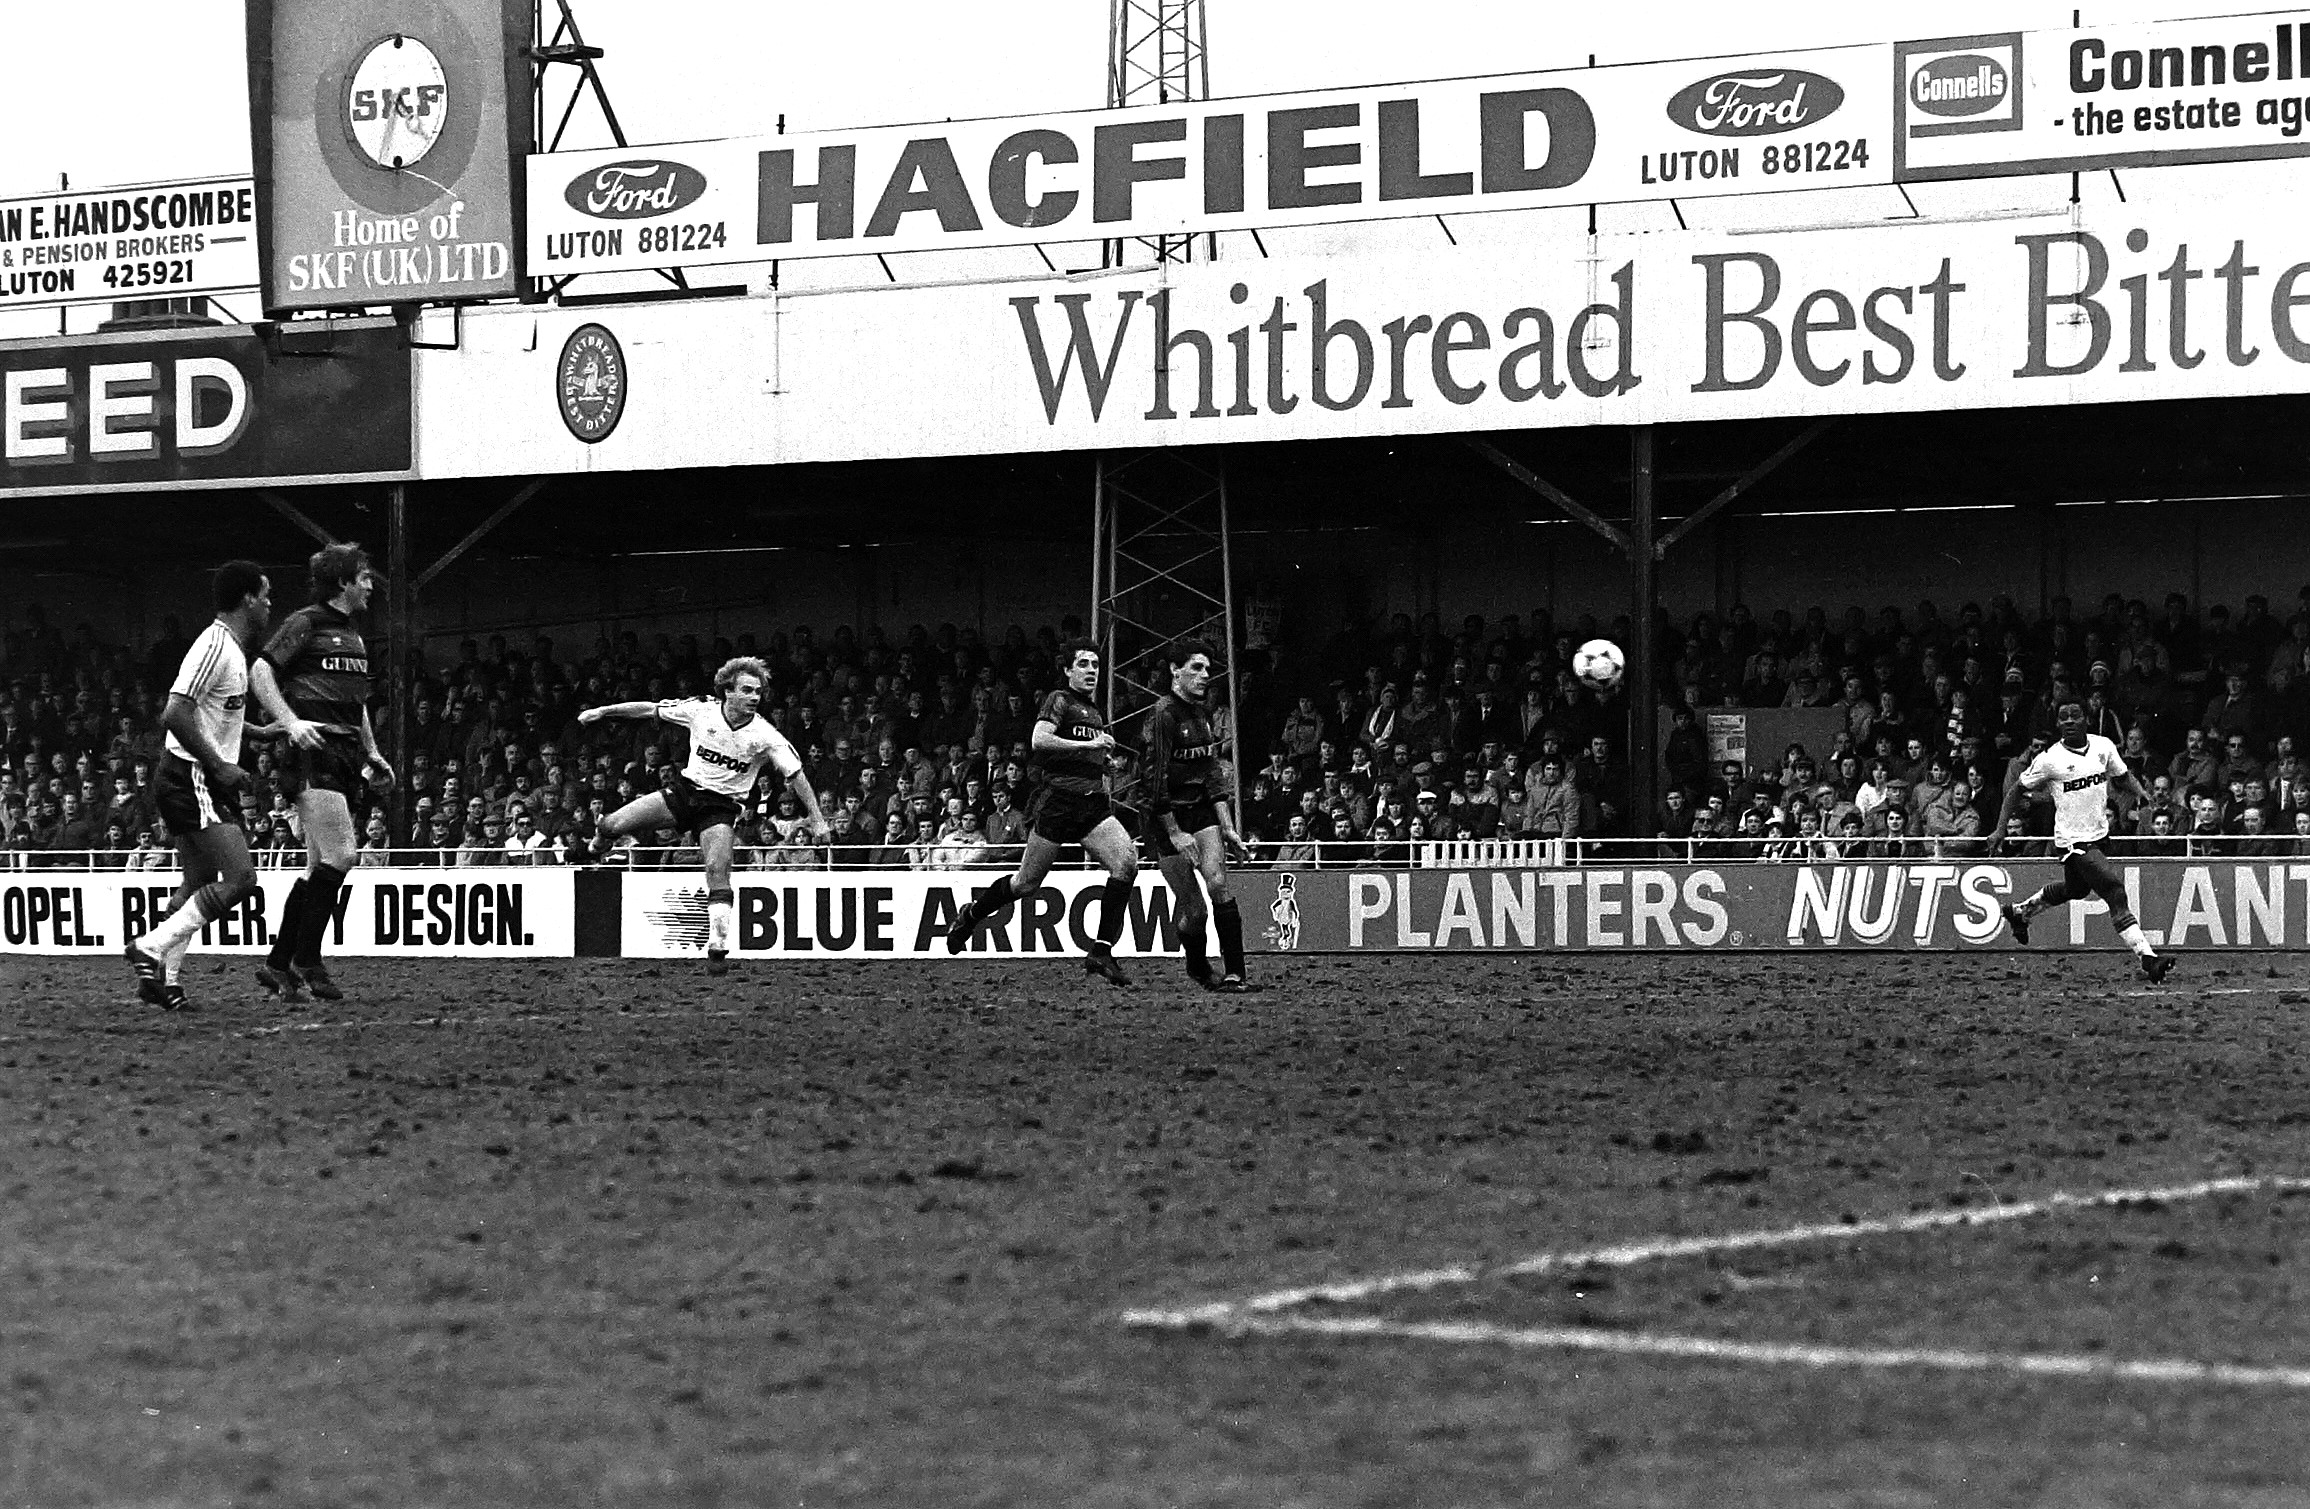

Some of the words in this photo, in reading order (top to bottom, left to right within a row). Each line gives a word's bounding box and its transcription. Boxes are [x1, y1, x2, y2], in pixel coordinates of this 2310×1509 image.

[353, 84, 445, 121] SKF
[1695, 74, 1809, 129] Ford
[1917, 65, 2004, 102] Connells
[2072, 102, 2123, 136] the
[2134, 97, 2241, 131] estate
[2256, 96, 2310, 137] ag
[757, 87, 1596, 244] HACFIELD
[1642, 148, 1739, 184] LUTON
[1762, 138, 1869, 175] 881224
[588, 164, 678, 213] Ford
[31, 206, 49, 240] E.
[54, 188, 252, 238] HANDSCOMBE
[332, 209, 419, 247] Home
[429, 200, 465, 240] of
[3, 248, 14, 267] &
[22, 241, 108, 266] PENSION
[116, 233, 205, 259] BROKERS
[547, 228, 623, 260] LUTON
[638, 221, 727, 253] 881224
[0, 268, 74, 297] LUTON
[103, 259, 193, 288] 425921
[1009, 260, 1643, 425] Whitbread
[1691, 252, 1967, 393] Best
[2013, 228, 2310, 378] Bitte
[6, 357, 251, 464] EED
[4, 886, 104, 946] OPEL.
[122, 886, 277, 945] BEER.
[374, 883, 534, 945] DESIGN.
[739, 887, 894, 951] BLUE
[914, 884, 1185, 952] ARROW
[1349, 862, 1728, 947] PLANTERS
[1787, 865, 2012, 946] NUTS
